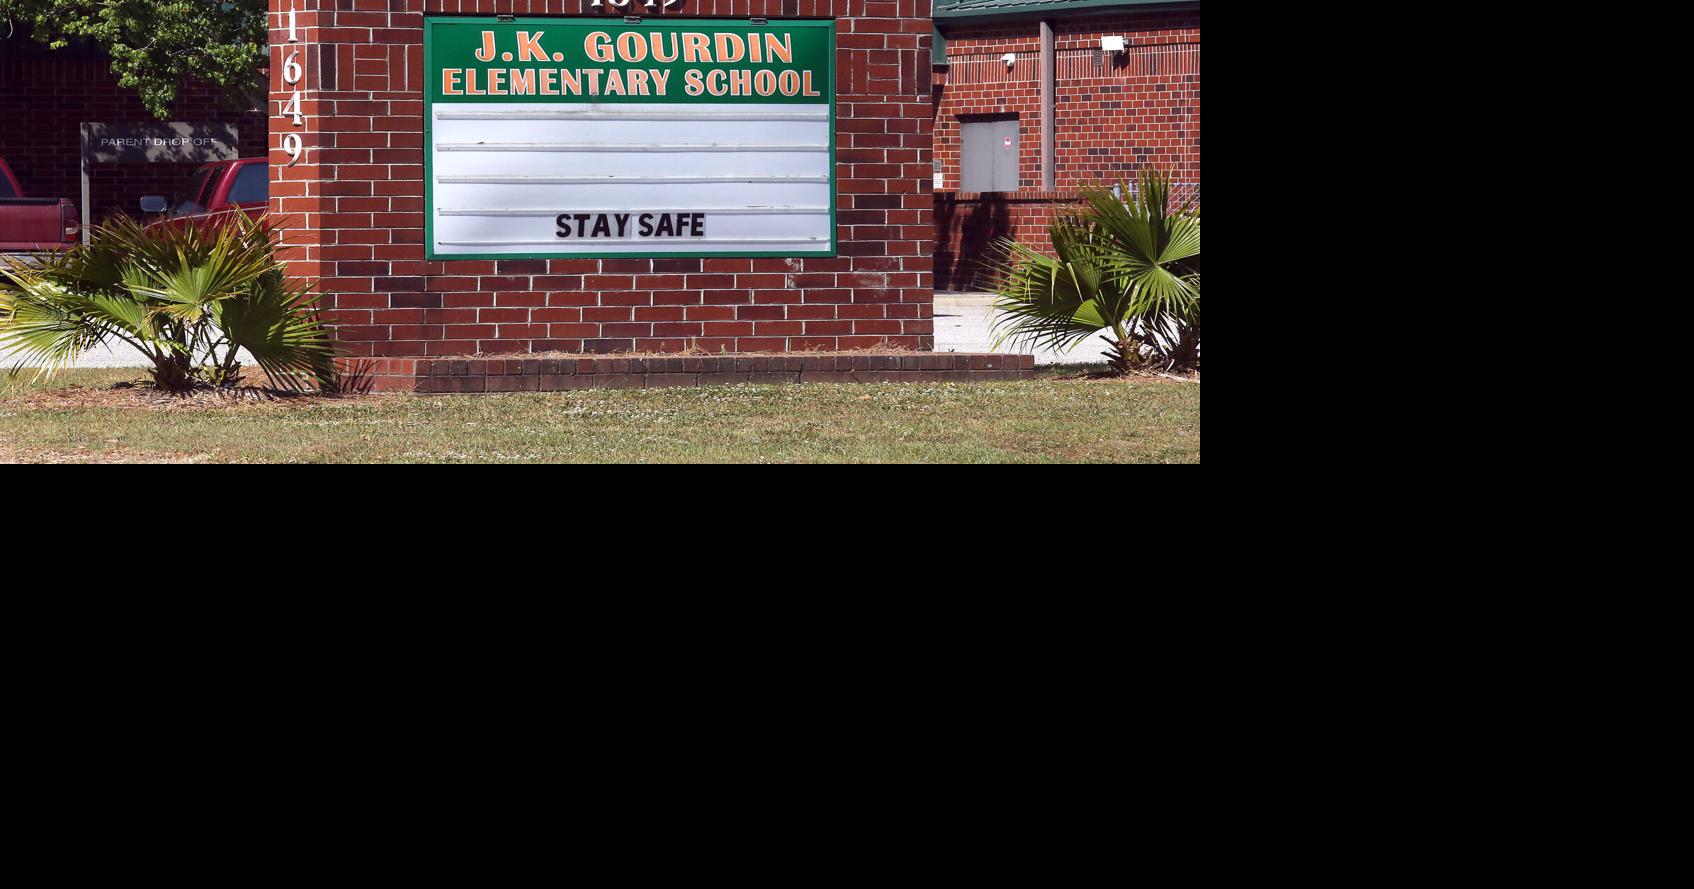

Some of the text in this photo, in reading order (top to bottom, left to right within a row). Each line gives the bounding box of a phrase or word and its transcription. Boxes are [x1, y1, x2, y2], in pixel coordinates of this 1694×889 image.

[474, 30, 793, 63] J.K. GOURDIN
[282, 8, 302, 167] 1649
[441, 68, 820, 97] ELEMENTARY SCHOOL
[101, 137, 218, 146] PARENT DROP OFF
[555, 212, 705, 238] STAY SAFE
